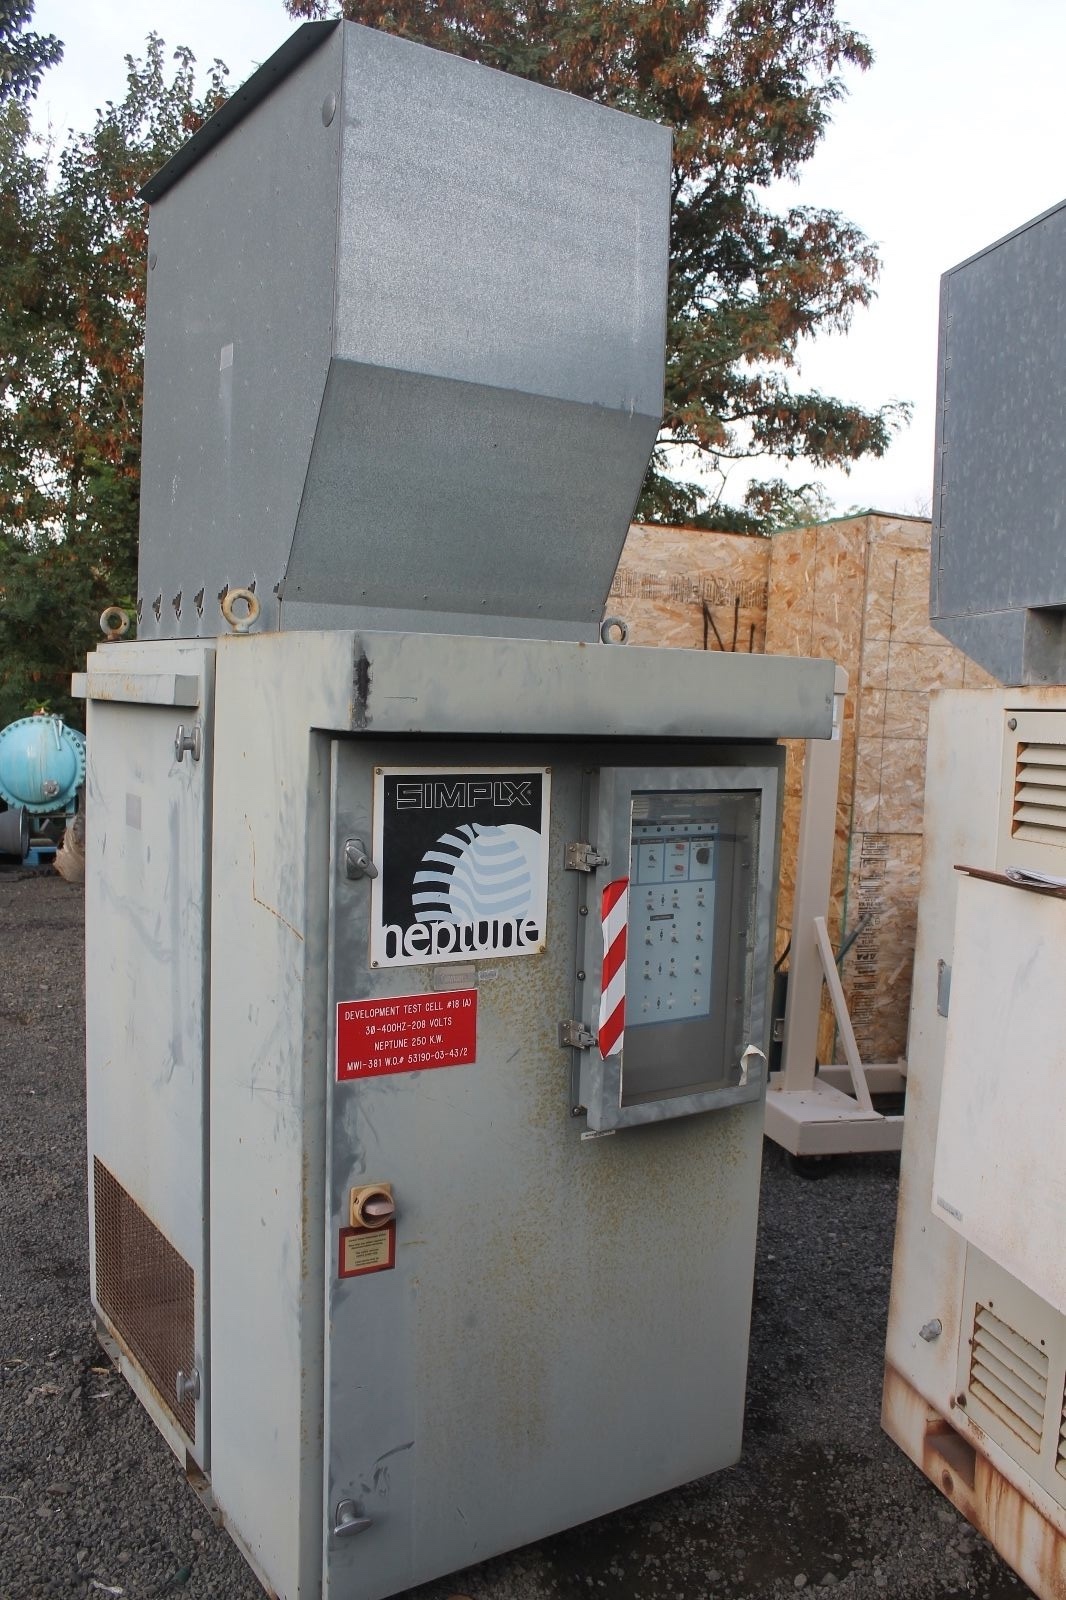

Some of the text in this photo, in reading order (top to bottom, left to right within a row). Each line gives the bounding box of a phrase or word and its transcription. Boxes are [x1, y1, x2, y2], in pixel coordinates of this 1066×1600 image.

[396, 781, 532, 810] SIMPLX
[384, 916, 540, 959] neptune
[344, 998, 472, 1021] DEVELOPMENT TEST CELL #18 (A)
[429, 1016, 453, 1028] VOLTS
[374, 1038, 409, 1051] NEPTUNE
[429, 1034, 444, 1045] K.W.
[346, 1047, 468, 1071] MWI-381 W.O.# 53190-03-43/2
